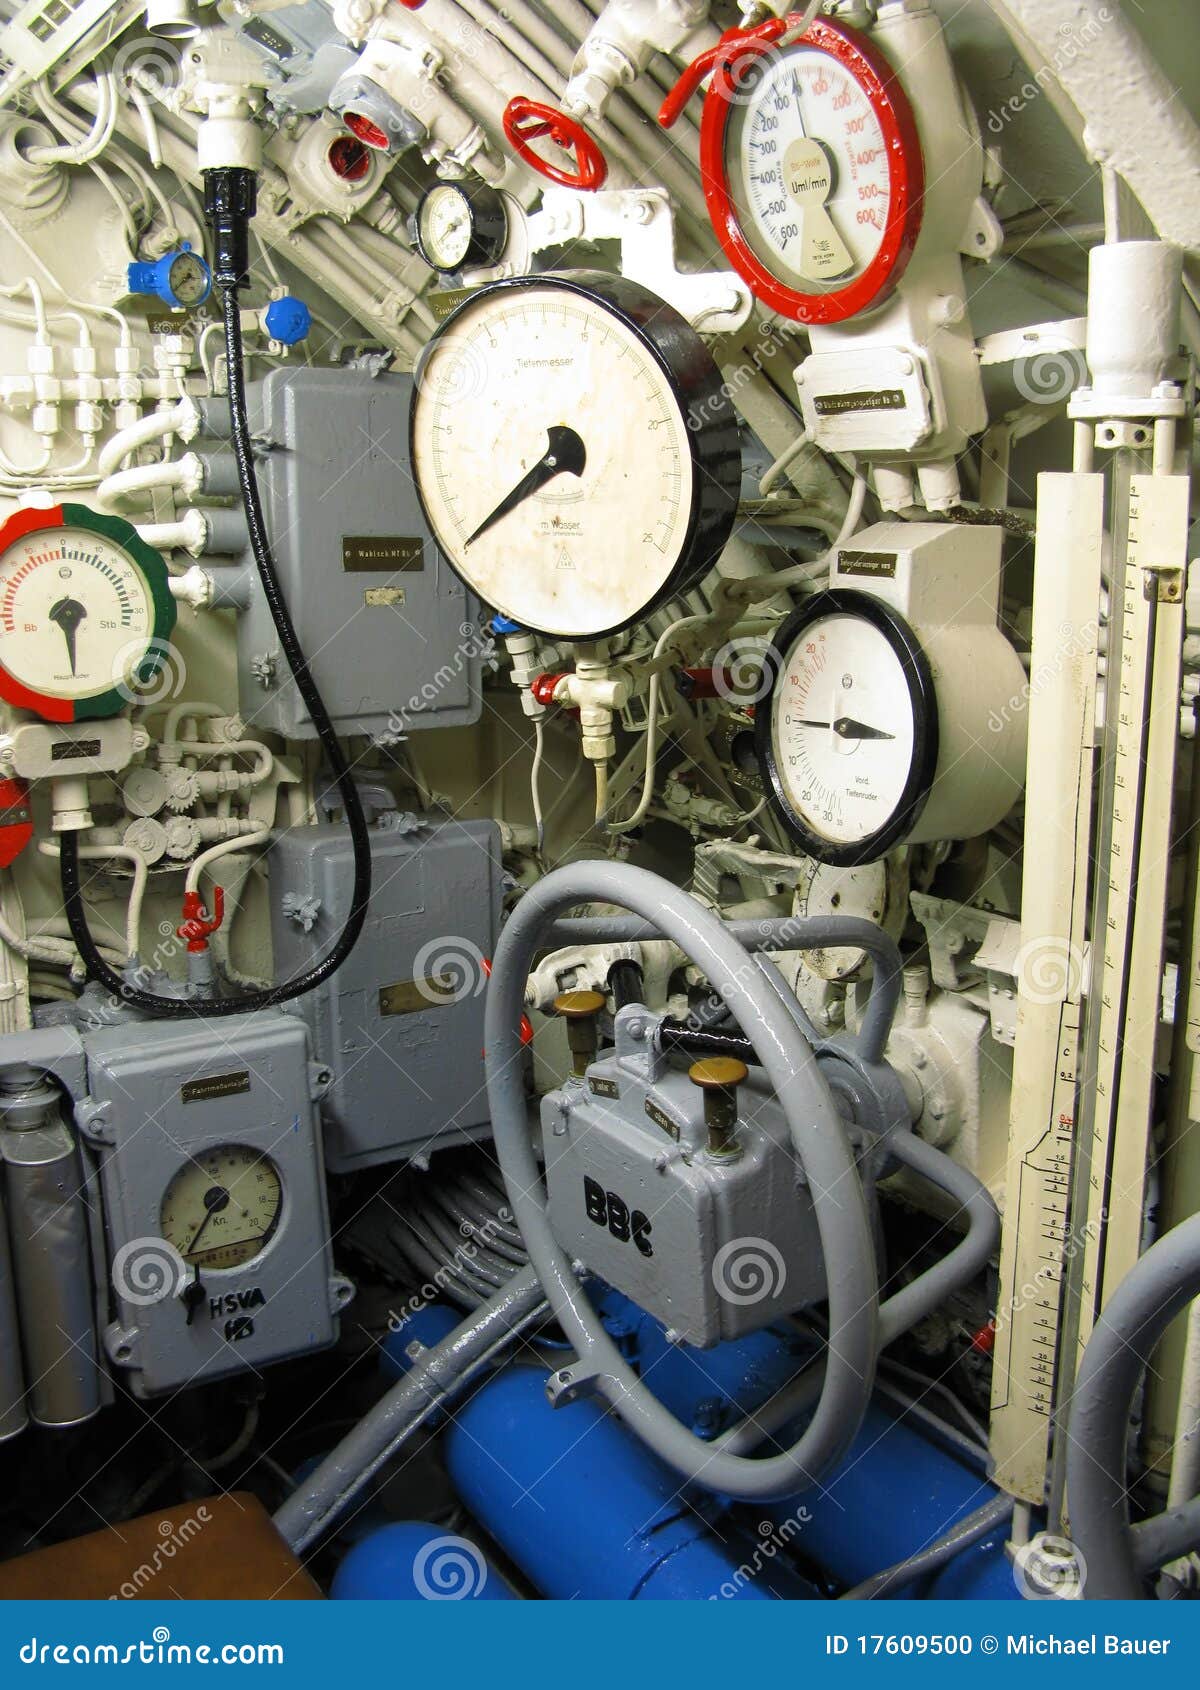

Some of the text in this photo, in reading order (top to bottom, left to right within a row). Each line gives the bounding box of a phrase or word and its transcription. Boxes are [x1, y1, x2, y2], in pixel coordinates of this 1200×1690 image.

[812, 80, 828, 96] 100
[774, 95, 790, 111] 100
[832, 94, 851, 110] 200
[761, 116, 778, 132] 200
[845, 118, 864, 135] 300
[759, 140, 776, 155] 300
[857, 149, 875, 165] 400
[760, 170, 777, 185] 400
[858, 184, 878, 199] 500
[769, 200, 786, 215] 500
[856, 209, 876, 225] 600
[781, 224, 798, 240] 600
[580, 333, 589, 342] 15
[517, 356, 573, 369] Tiefenmesser
[446, 425, 452, 435] 5
[648, 420, 659, 430] 20
[60, 538, 66, 546] 0
[643, 533, 653, 543] 25
[95, 546, 103, 554] 10
[24, 623, 38, 633] Bb
[99, 620, 117, 630] Stb
[806, 643, 816, 654] 20
[790, 675, 799, 686] 10
[785, 715, 791, 725] 0
[789, 756, 797, 766] 10
[802, 791, 812, 802] 20
[822, 811, 833, 822] 30
[1063, 1048, 1070, 1057] C
[1060, 1071, 1072, 1079] 0,2
[258, 1196, 266, 1204] 18
[212, 1216, 228, 1226] Kn.
[584, 1174, 653, 1258] BBC
[249, 1218, 259, 1227] 20
[185, 1234, 191, 1243] 0
[210, 1287, 266, 1320] HSVA
